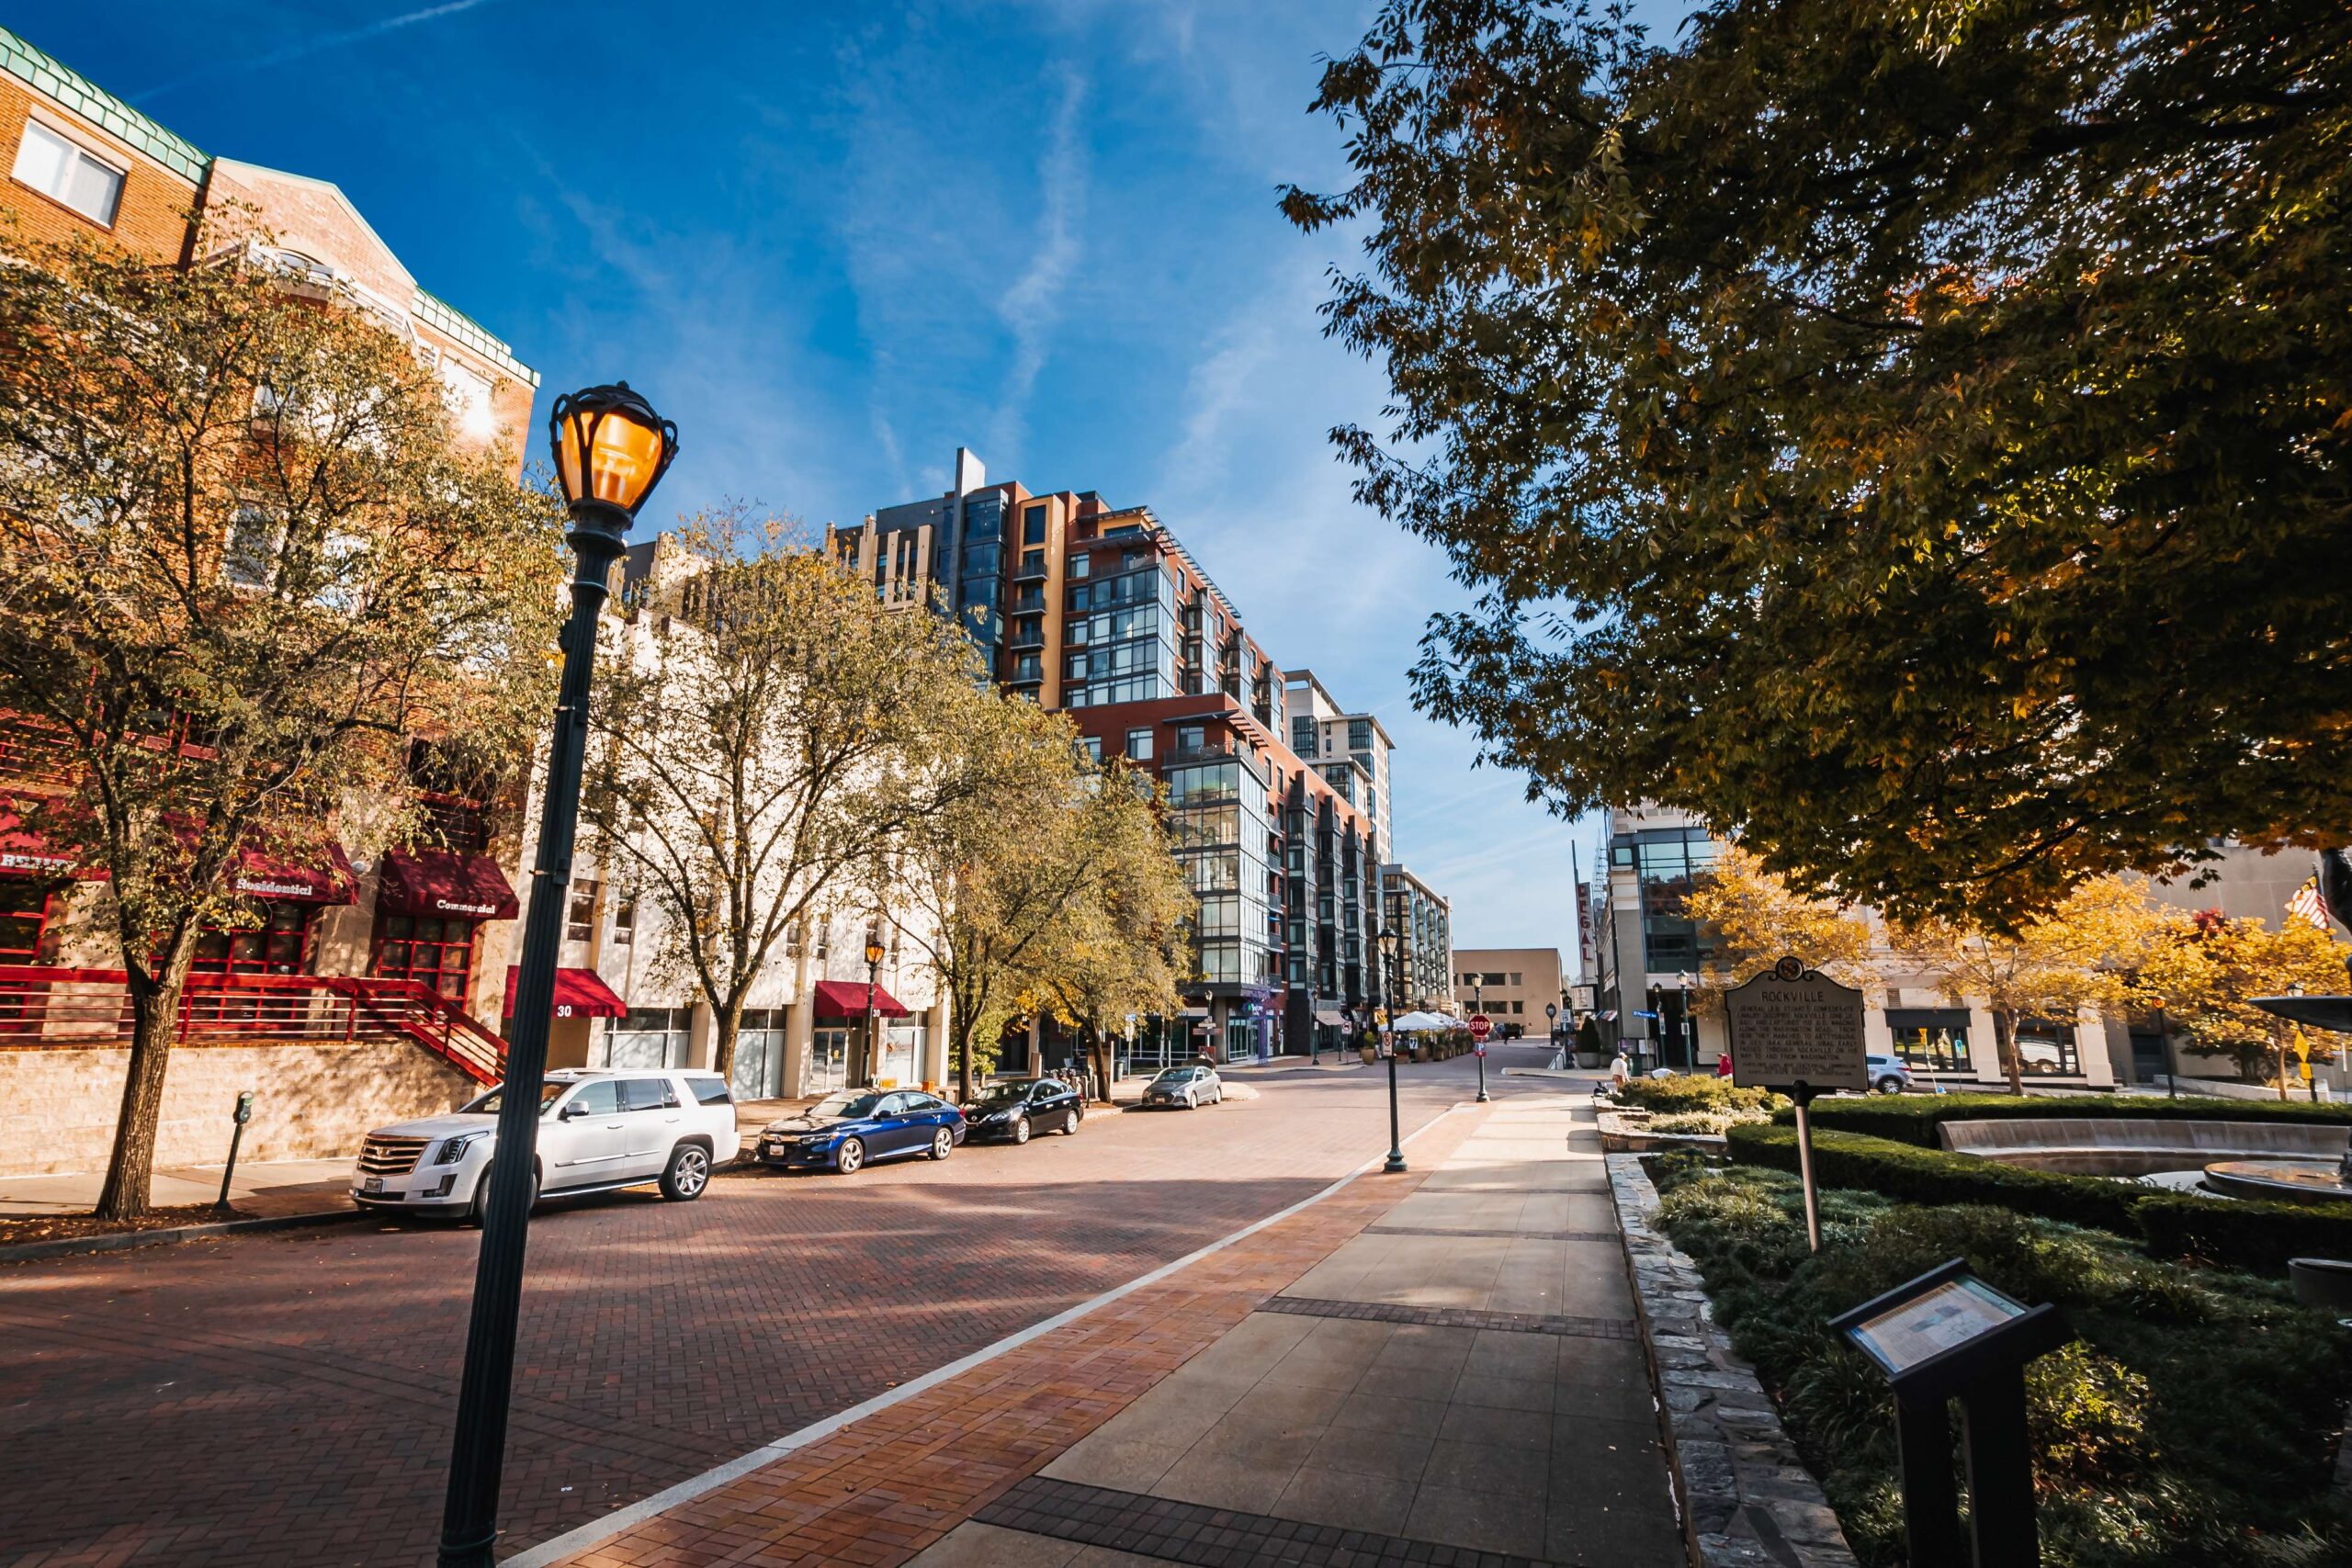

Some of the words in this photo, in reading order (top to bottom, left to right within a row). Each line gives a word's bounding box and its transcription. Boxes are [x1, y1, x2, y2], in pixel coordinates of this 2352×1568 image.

[236, 878, 312, 896] Residential
[436, 899, 496, 914] Commercial
[1761, 991, 1824, 1002] ROCKVILLE
[557, 1005, 572, 1018] 30
[873, 1009, 880, 1018] 30
[1470, 1021, 1489, 1031] STOP
